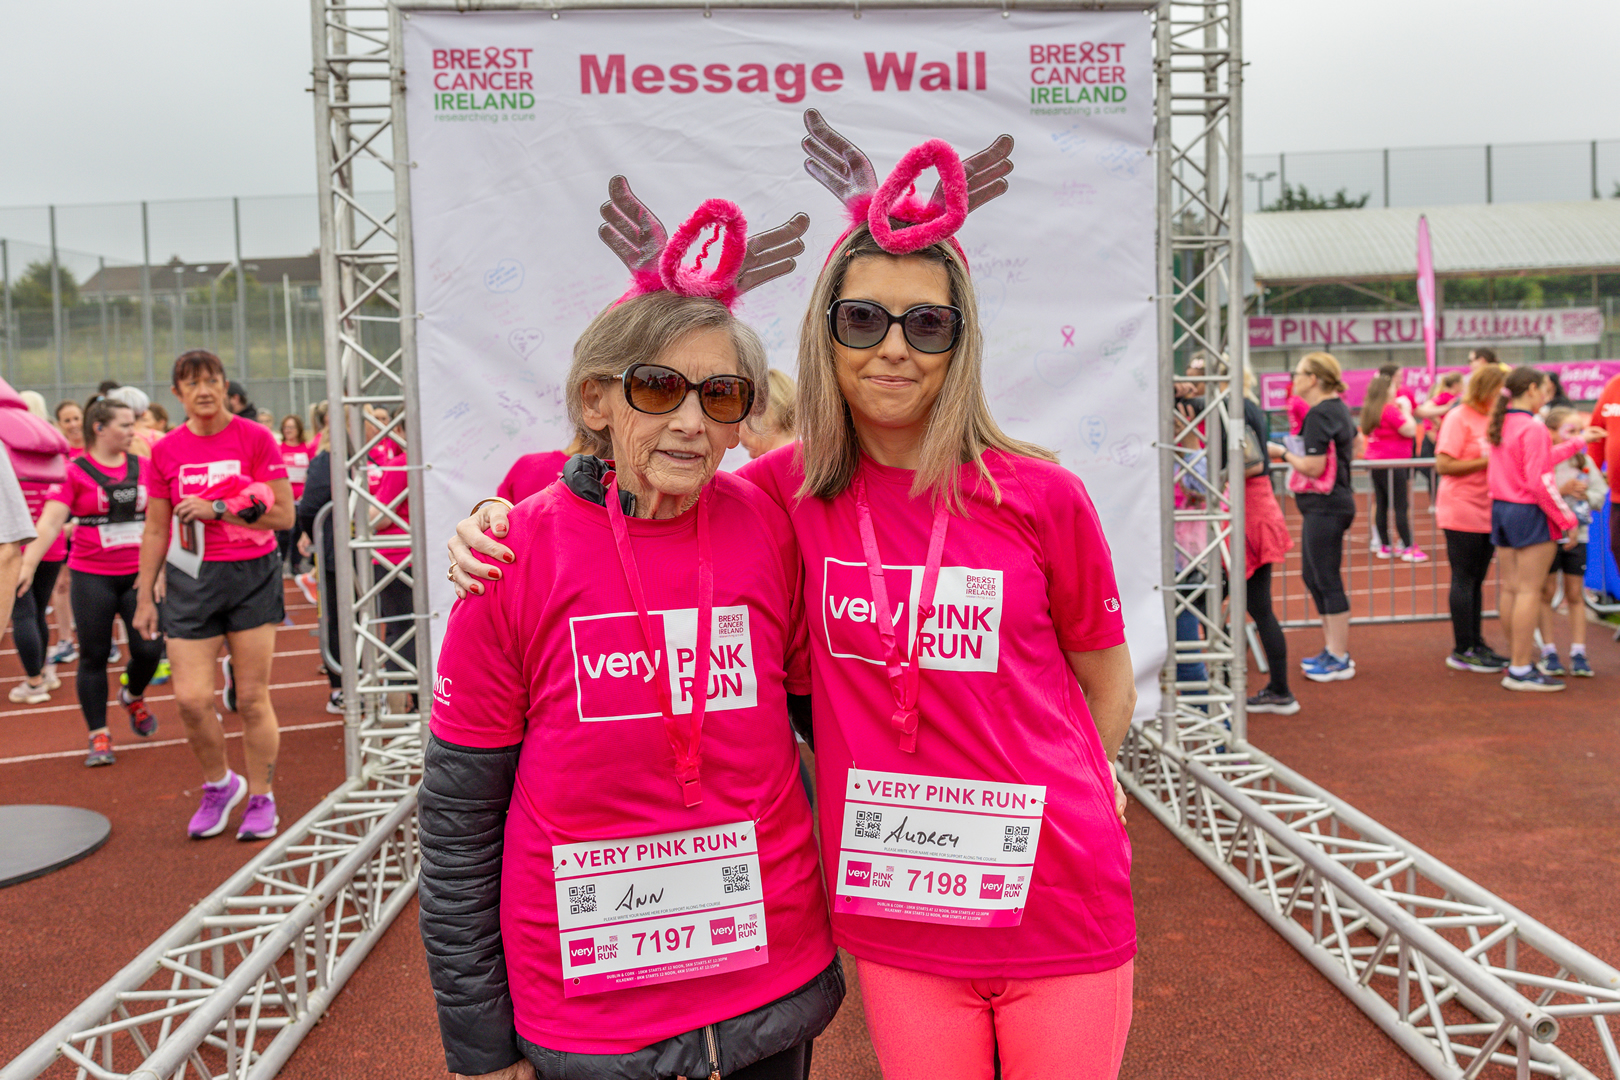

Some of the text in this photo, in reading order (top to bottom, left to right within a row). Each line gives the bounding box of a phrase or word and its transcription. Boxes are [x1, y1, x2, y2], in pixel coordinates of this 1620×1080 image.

[433, 72, 534, 90] CANCER
[579, 51, 988, 104] Message Wall
[1031, 66, 1126, 85] CANCER
[1031, 85, 1127, 104] IRELAND
[434, 92, 535, 110] IRELAND
[1030, 106, 1091, 117] researching
[1103, 106, 1127, 114] cure
[434, 112, 536, 123] researching a cure
[1280, 319, 1360, 343] PINK
[966, 582, 996, 591] CANCER
[965, 588, 997, 597] IRELAND
[718, 621, 744, 629] CANCER
[718, 627, 744, 635] IRELAND
[918, 632, 983, 660] RUN
[676, 643, 747, 674] PNK
[582, 649, 661, 684] very
[867, 779, 1027, 810] VERY PINK RUN
[573, 831, 738, 869] VERY PINK RUN
[848, 869, 870, 880] very
[873, 871, 894, 881] PINK
[872, 879, 891, 888] RUN
[907, 868, 967, 897] 7198
[982, 882, 1003, 893] very
[1005, 883, 1024, 891] PINK
[1004, 890, 1021, 898] RUN
[711, 925, 734, 936] very
[737, 920, 758, 932] PINK
[738, 928, 757, 939] RUN
[631, 925, 696, 956] 7197
[571, 946, 593, 957] very
[597, 943, 619, 953] PINK
[597, 951, 617, 961] RUN
